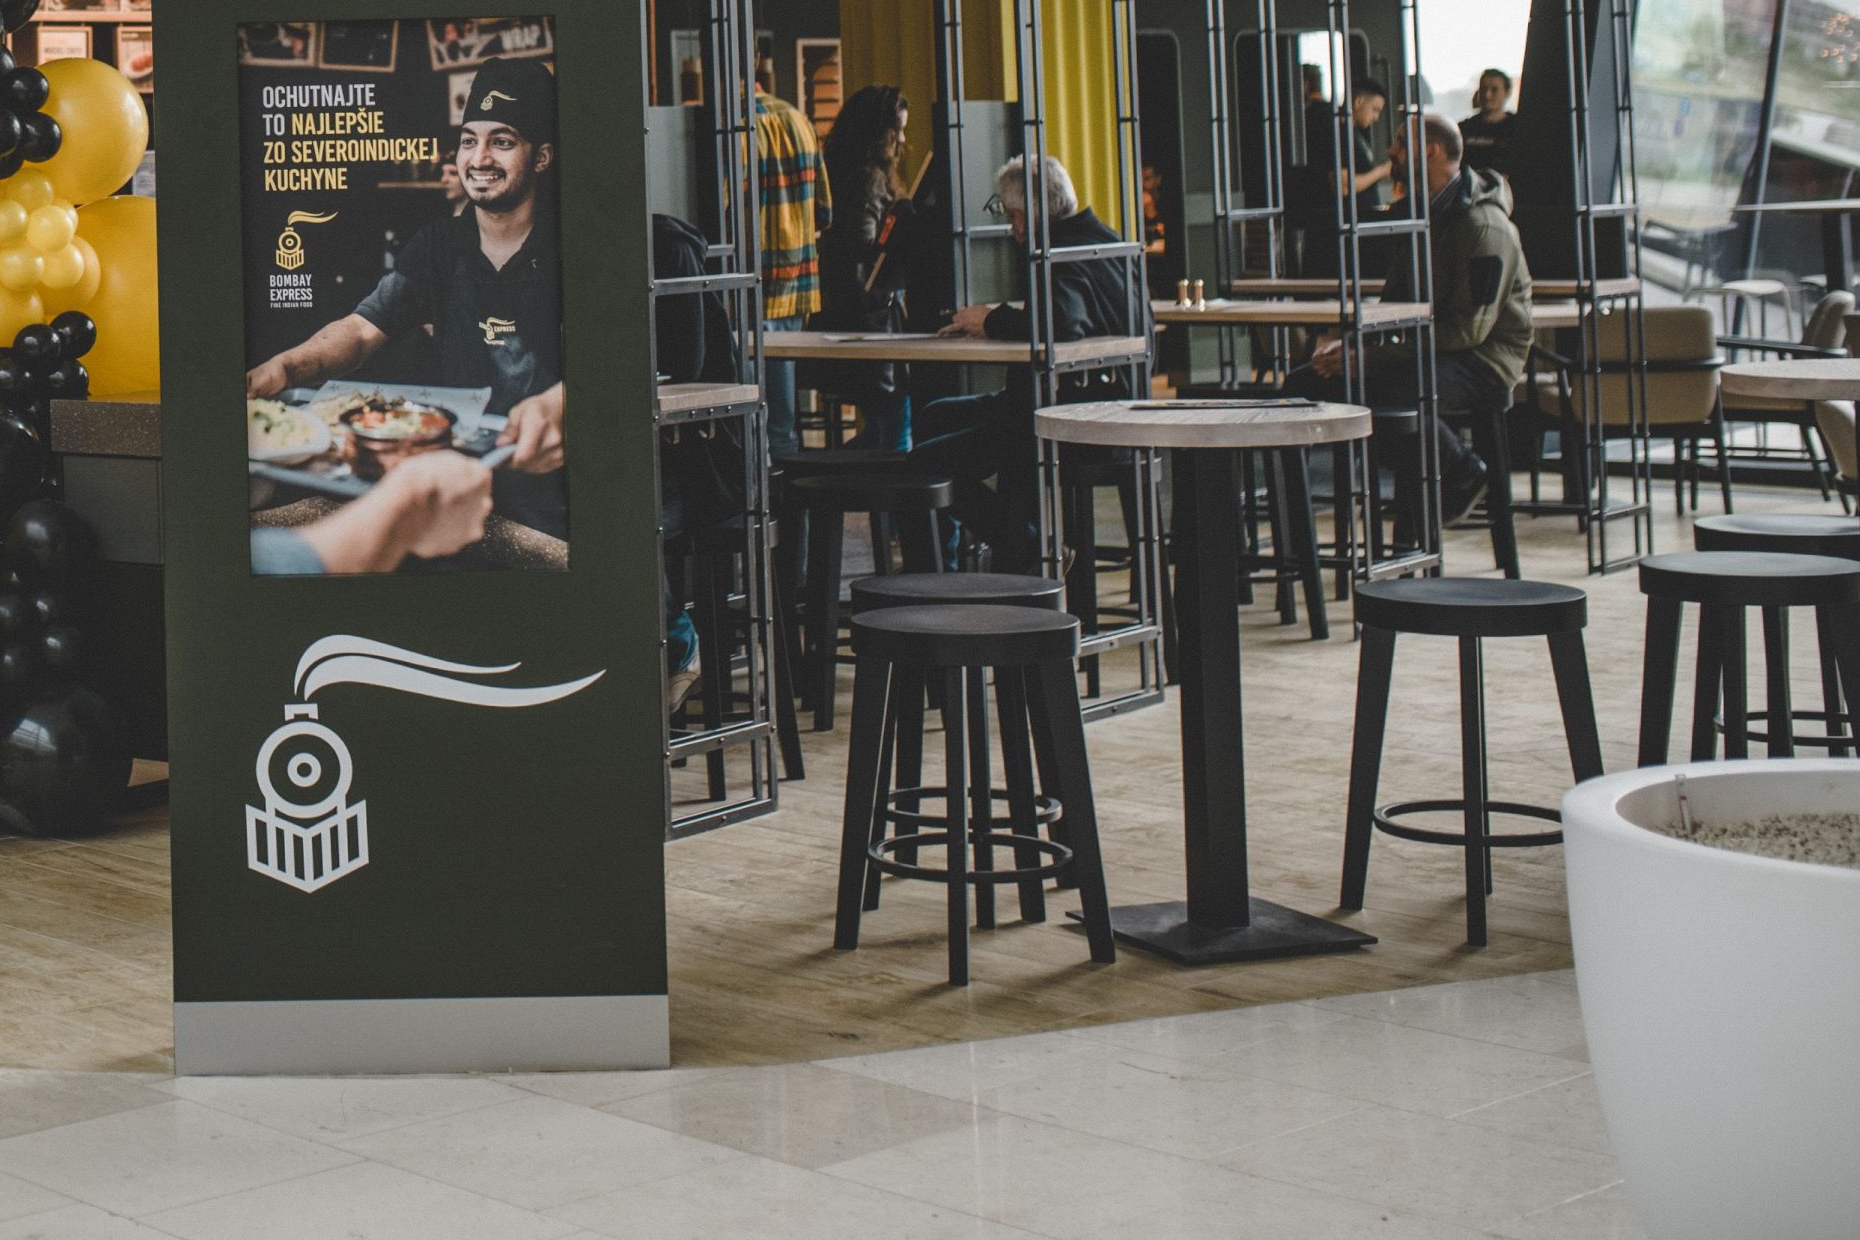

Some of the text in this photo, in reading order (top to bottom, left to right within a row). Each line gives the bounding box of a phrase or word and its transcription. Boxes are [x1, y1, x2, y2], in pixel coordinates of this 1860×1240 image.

[262, 83, 376, 109] OCHUTNAJTE
[262, 107, 384, 136] TO NAJLEPŠIE
[263, 137, 438, 163] ZO SEVEROINDICKEJ
[265, 167, 348, 191] KUCHYNE
[269, 274, 312, 287] BOMBAY
[270, 288, 313, 301] EXPRESS
